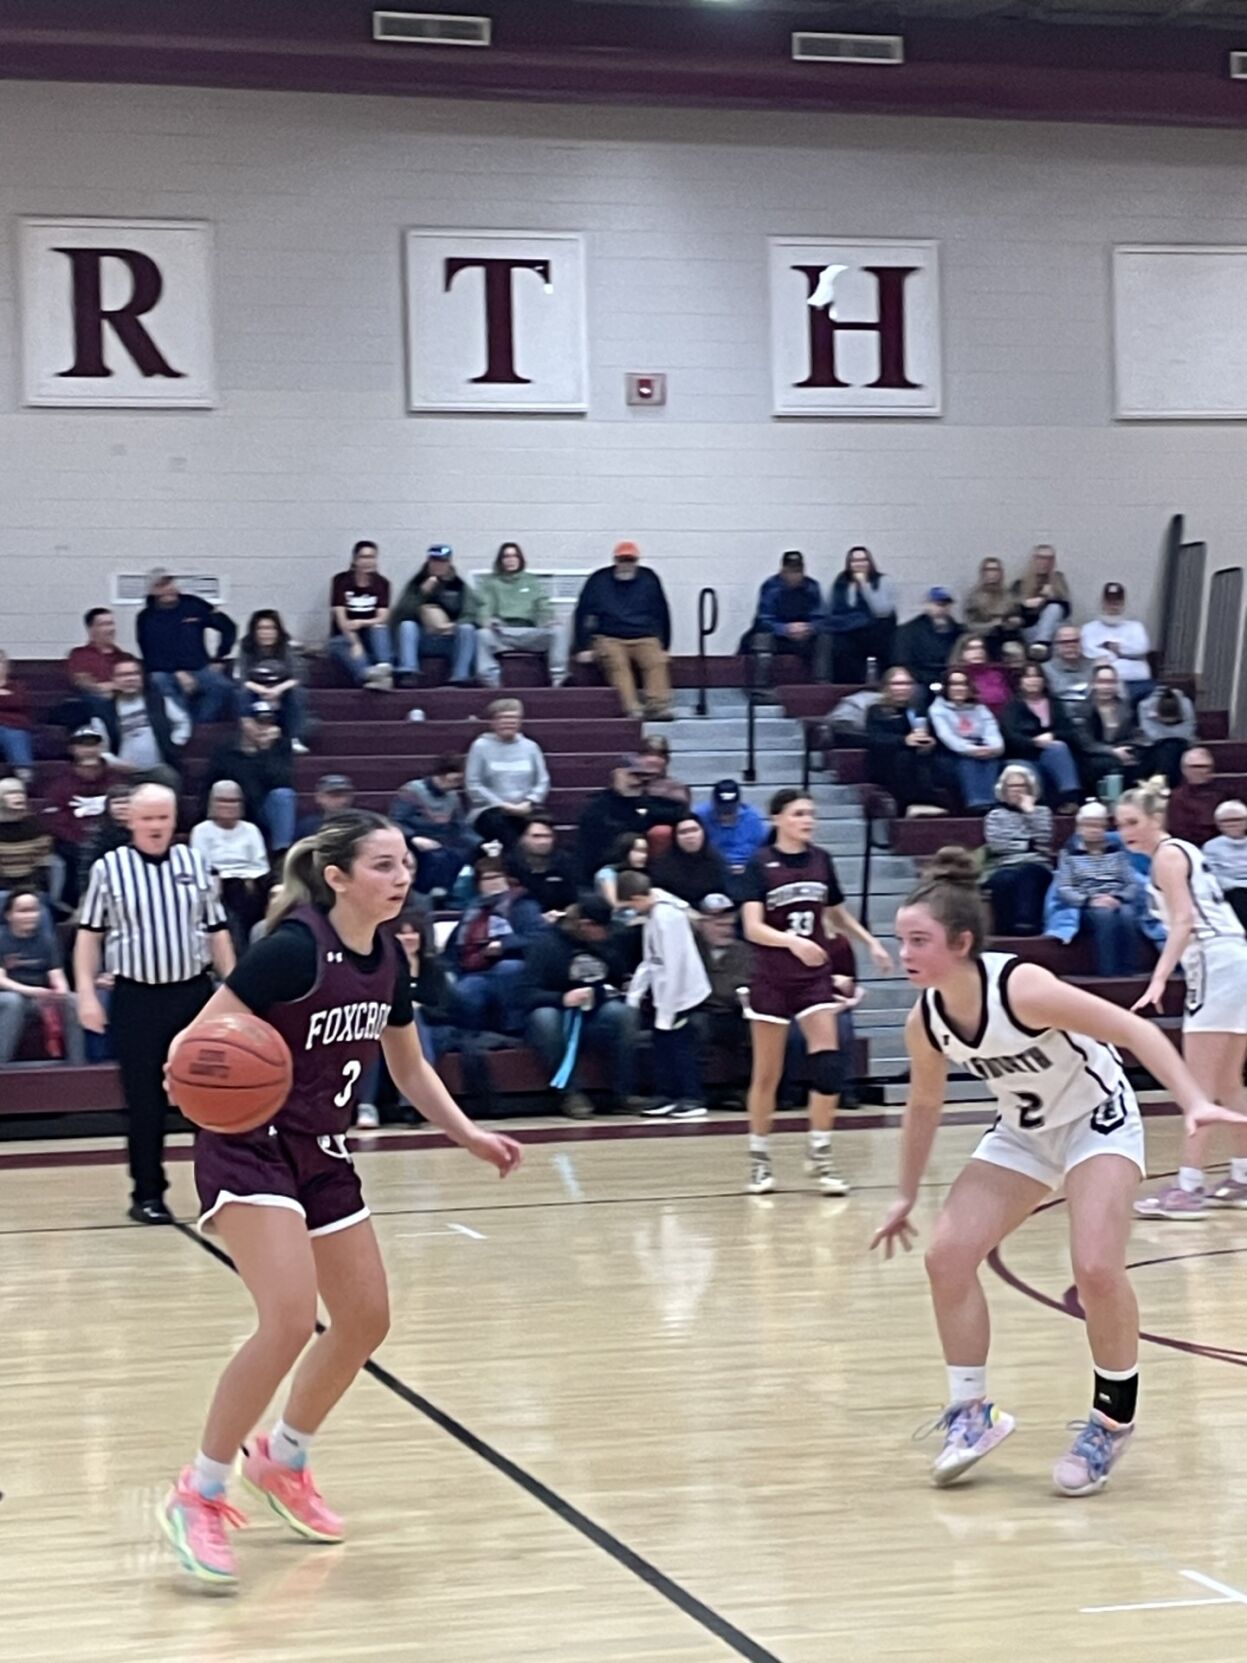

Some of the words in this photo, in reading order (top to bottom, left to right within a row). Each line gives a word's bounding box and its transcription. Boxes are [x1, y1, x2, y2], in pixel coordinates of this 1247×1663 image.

[50, 247, 188, 379] R
[443, 257, 551, 385] T
[789, 264, 923, 388] H
[305, 1002, 392, 1050] FOXCRO
[333, 1060, 361, 1107] 3
[1011, 1091, 1045, 1129] 2
